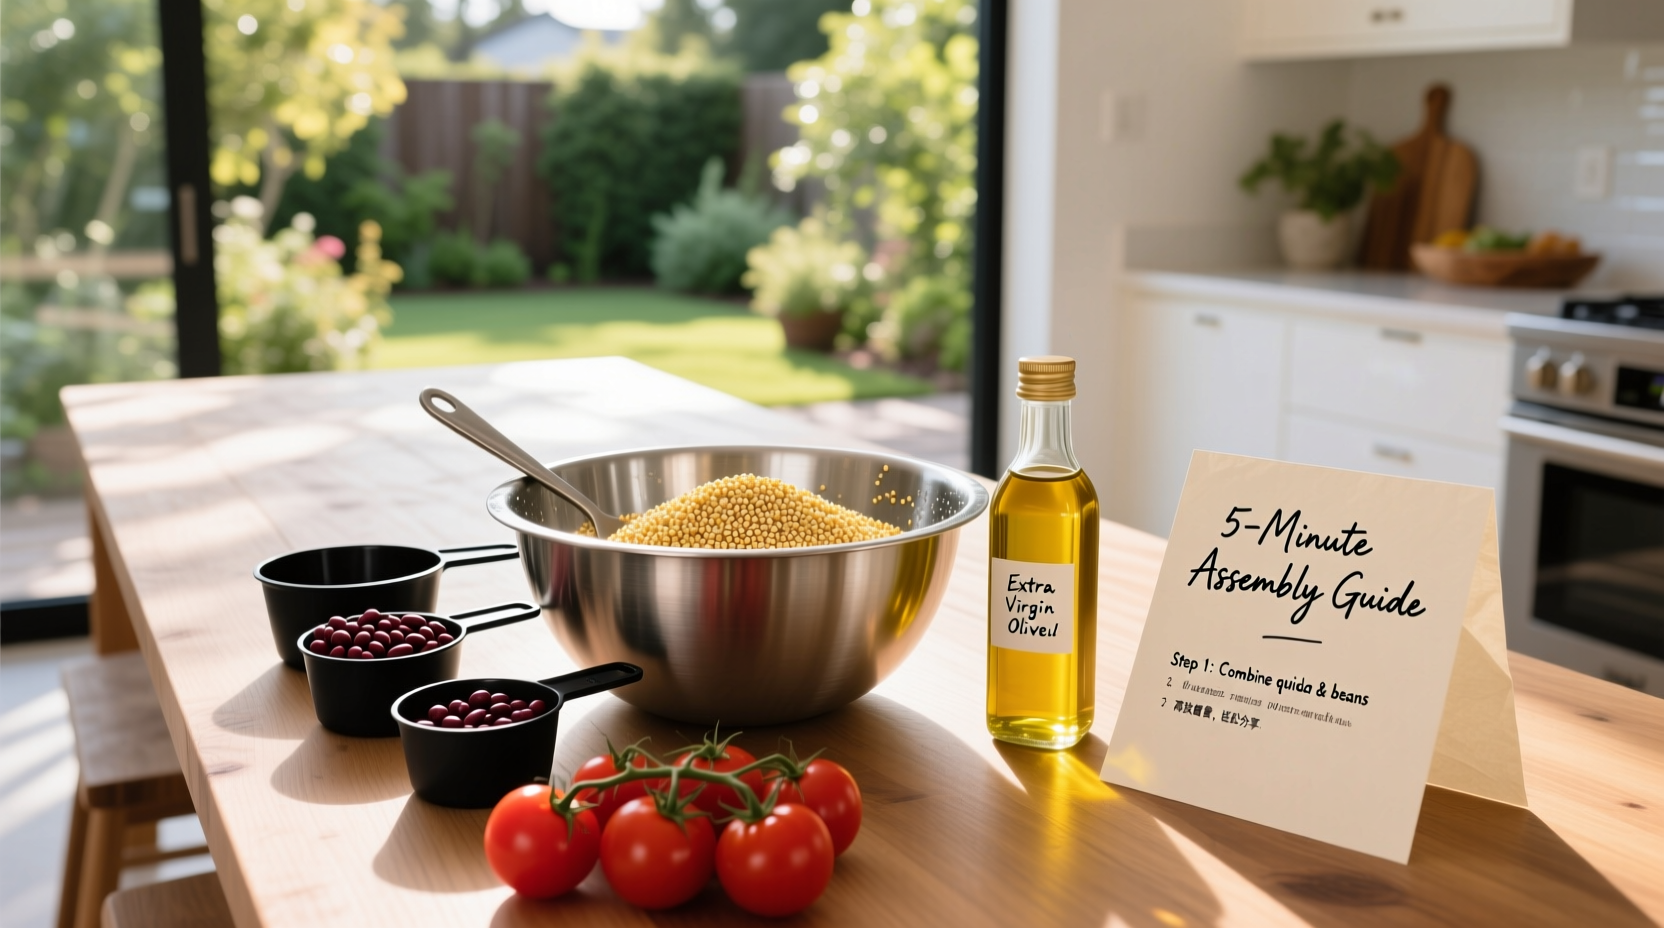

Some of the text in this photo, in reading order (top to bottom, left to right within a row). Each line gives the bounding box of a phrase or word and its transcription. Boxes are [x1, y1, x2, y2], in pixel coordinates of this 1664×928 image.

[1220, 506, 1373, 556] 5-Minute
[1005, 595, 1055, 620] Virgin
[1007, 574, 1056, 594] Extra
[1187, 547, 1426, 624] Assembly Guide
[1170, 651, 1199, 674] Step
[1204, 658, 1215, 674] 1:
[1219, 661, 1273, 686] Combine
[1316, 681, 1327, 698] &
[1331, 683, 1369, 706] beans
